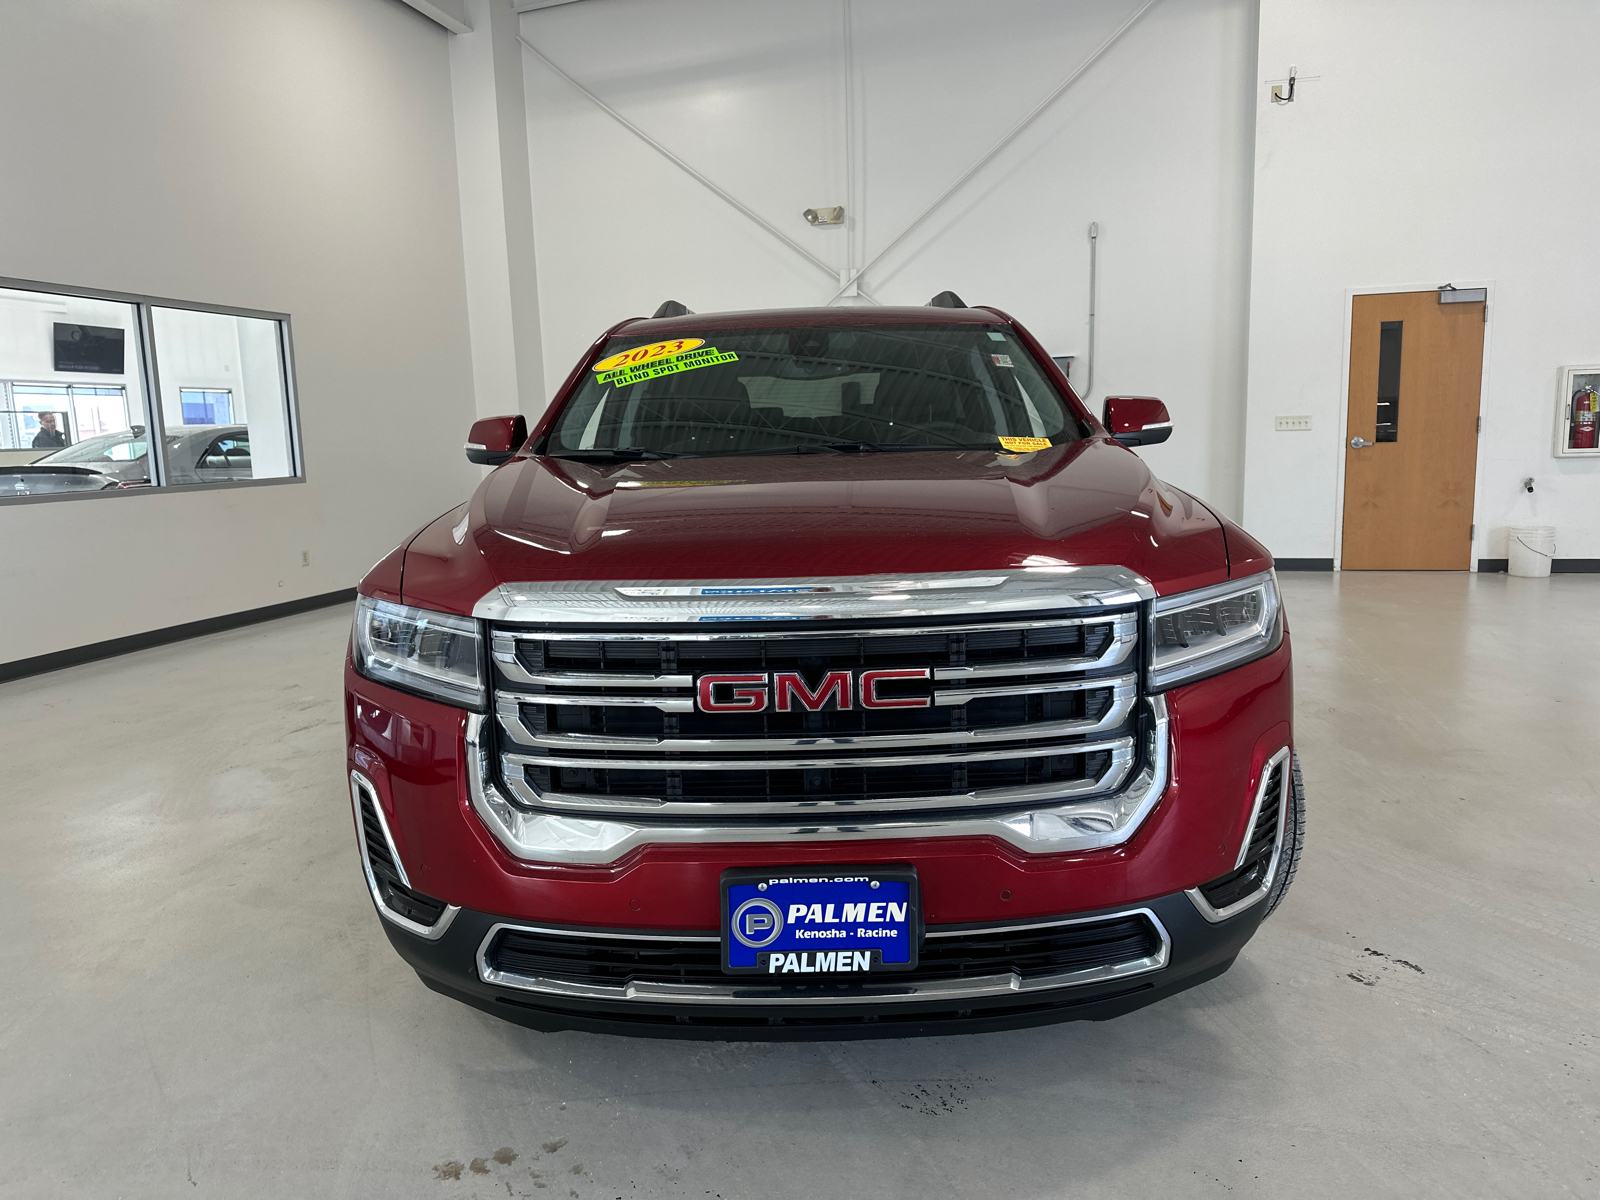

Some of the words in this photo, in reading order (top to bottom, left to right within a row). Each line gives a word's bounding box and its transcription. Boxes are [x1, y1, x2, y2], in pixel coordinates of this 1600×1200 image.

[613, 341, 684, 367] 2023
[602, 368, 628, 381] ALL
[630, 357, 675, 373] WHEEL
[676, 350, 715, 362] DRIVE
[616, 371, 650, 386] BLIND
[653, 364, 680, 376] SPOT
[683, 353, 736, 368] MONITOR
[697, 667, 931, 713] GMC
[768, 876, 869, 885] palmen.com
[745, 913, 774, 935] P
[787, 902, 908, 924] PALMEN
[795, 928, 846, 939] Kenosha
[857, 927, 898, 938] Racine
[768, 951, 871, 973] PALMEN
